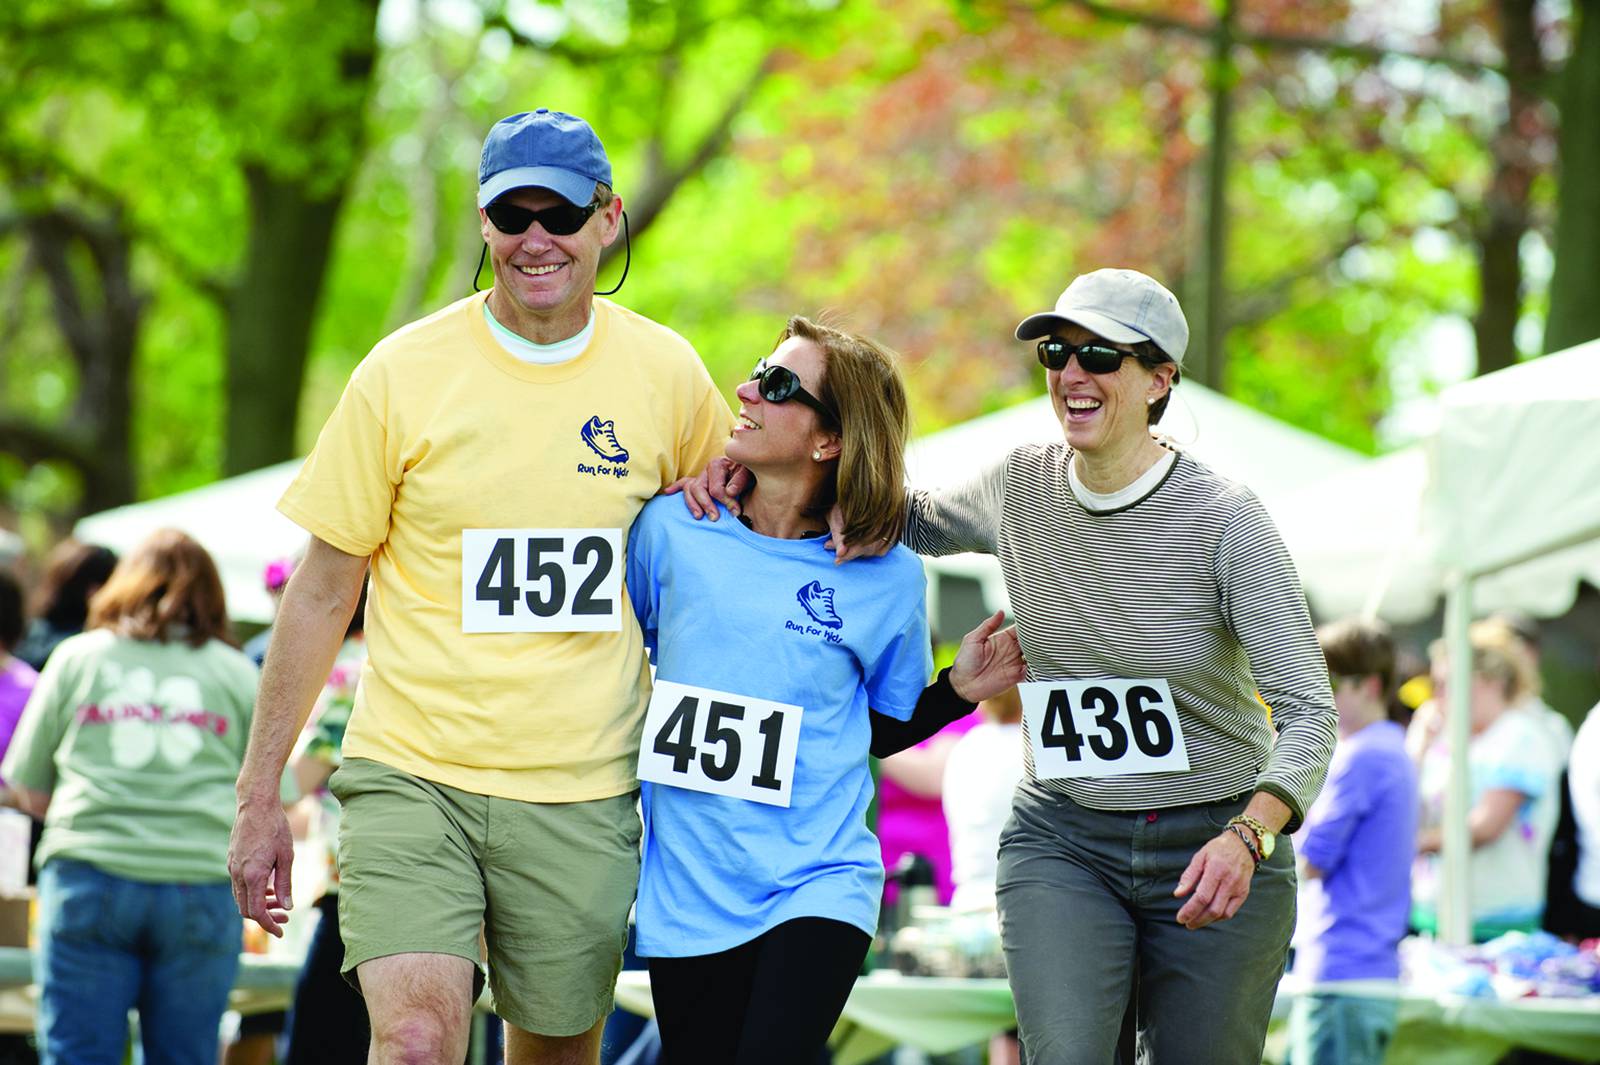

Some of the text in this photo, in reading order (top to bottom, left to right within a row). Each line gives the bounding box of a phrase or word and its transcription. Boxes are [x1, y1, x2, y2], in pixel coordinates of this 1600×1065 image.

[577, 463, 596, 476] Run
[597, 465, 611, 475] For
[475, 535, 614, 617] 452
[785, 620, 804, 635] Run
[806, 625, 822, 636] For
[653, 695, 785, 791] 451
[1041, 685, 1174, 762] 436
